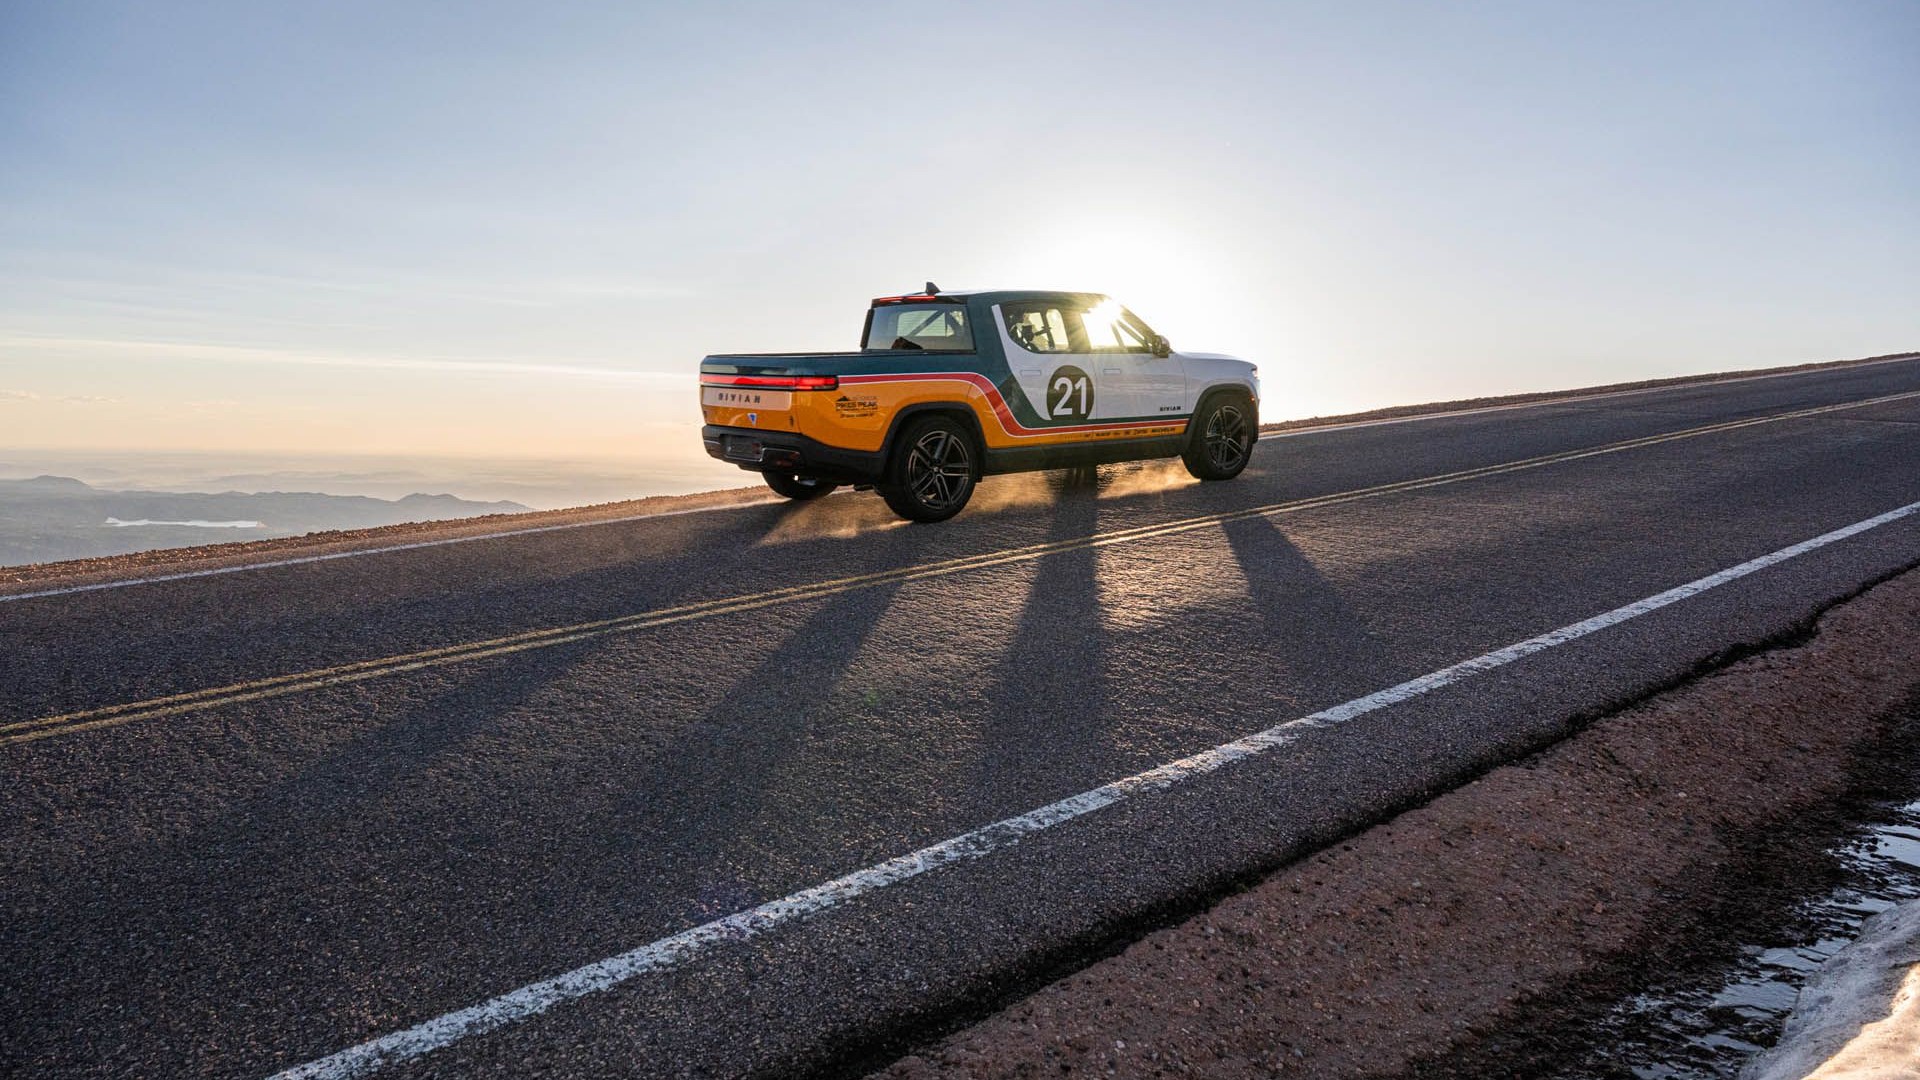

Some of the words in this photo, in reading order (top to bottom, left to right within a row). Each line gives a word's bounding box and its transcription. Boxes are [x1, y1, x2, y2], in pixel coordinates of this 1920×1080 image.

[718, 393, 761, 404] RIVIAN
[1053, 377, 1087, 416] 21
[857, 401, 878, 409] PEAK
